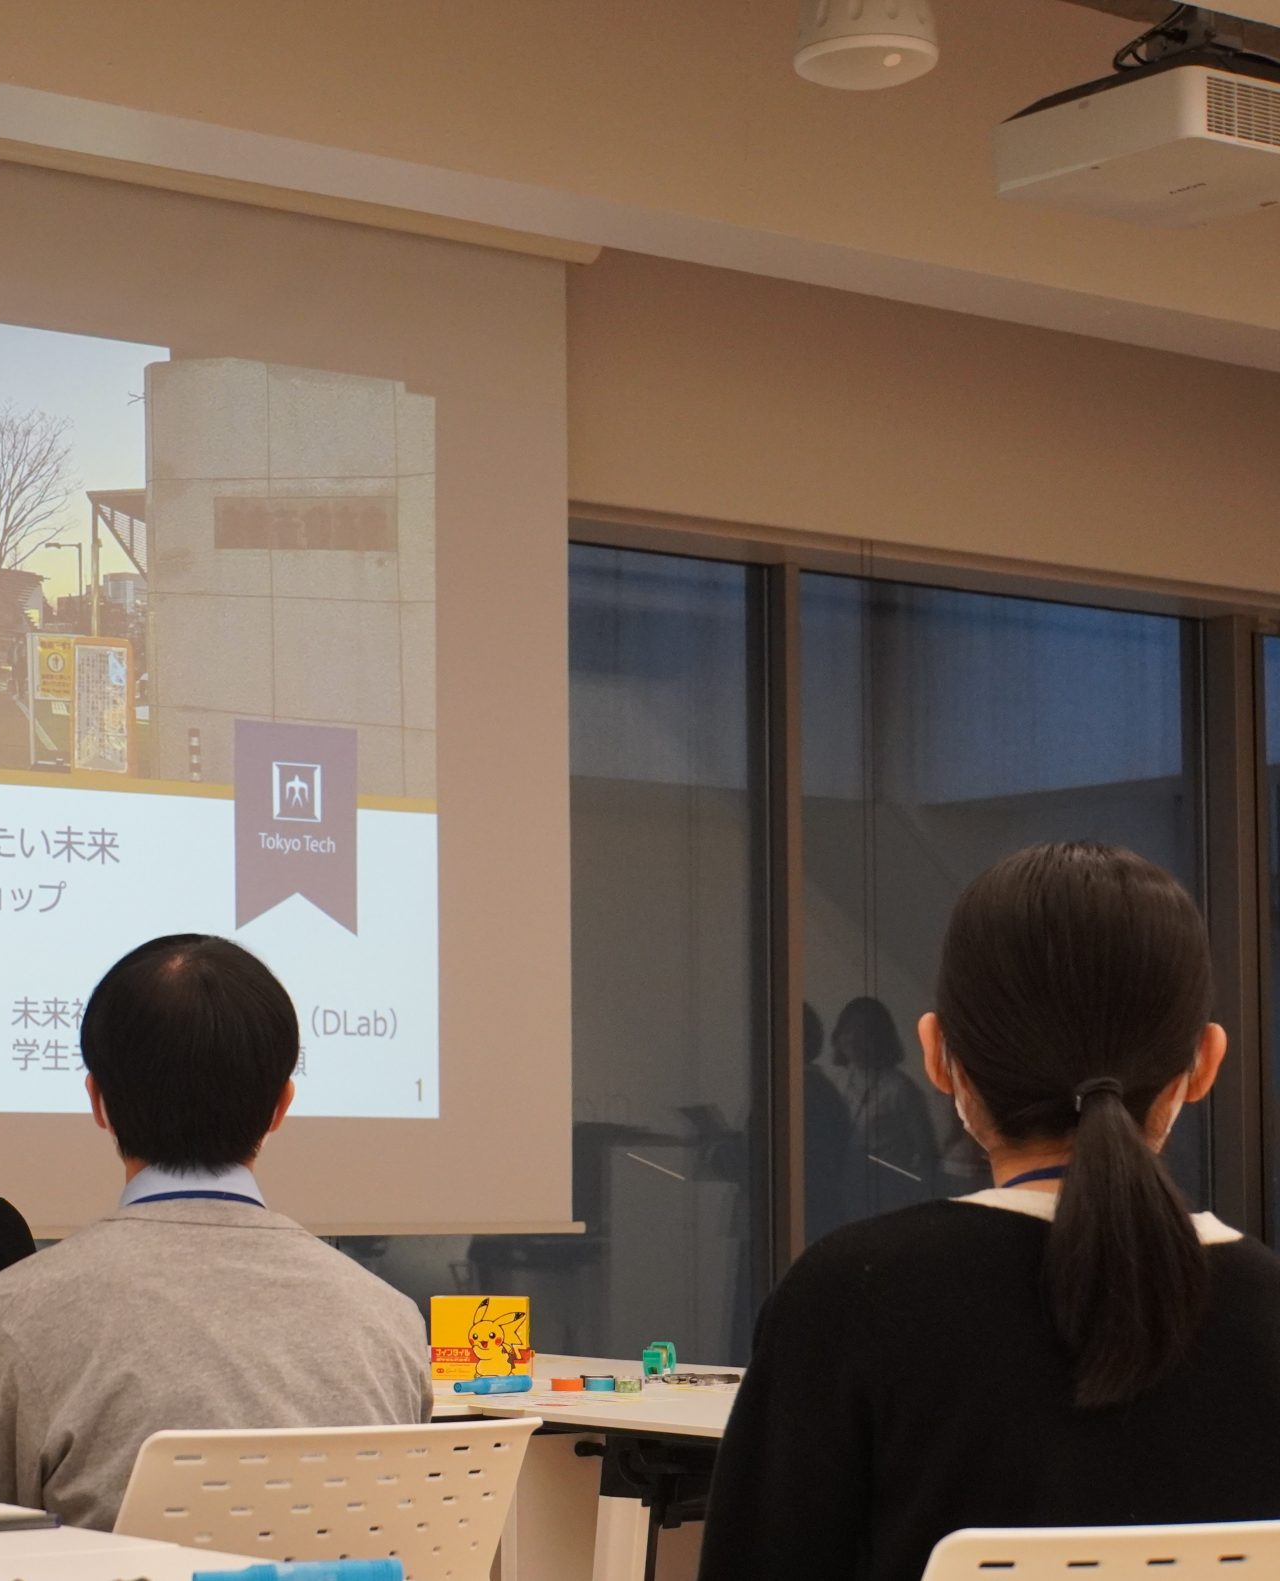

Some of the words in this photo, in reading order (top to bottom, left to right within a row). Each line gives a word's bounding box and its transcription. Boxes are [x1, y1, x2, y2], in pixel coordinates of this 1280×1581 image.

[257, 831, 302, 855] Tokyo
[302, 834, 337, 854] Tech
[415, 1077, 423, 1102] 1
